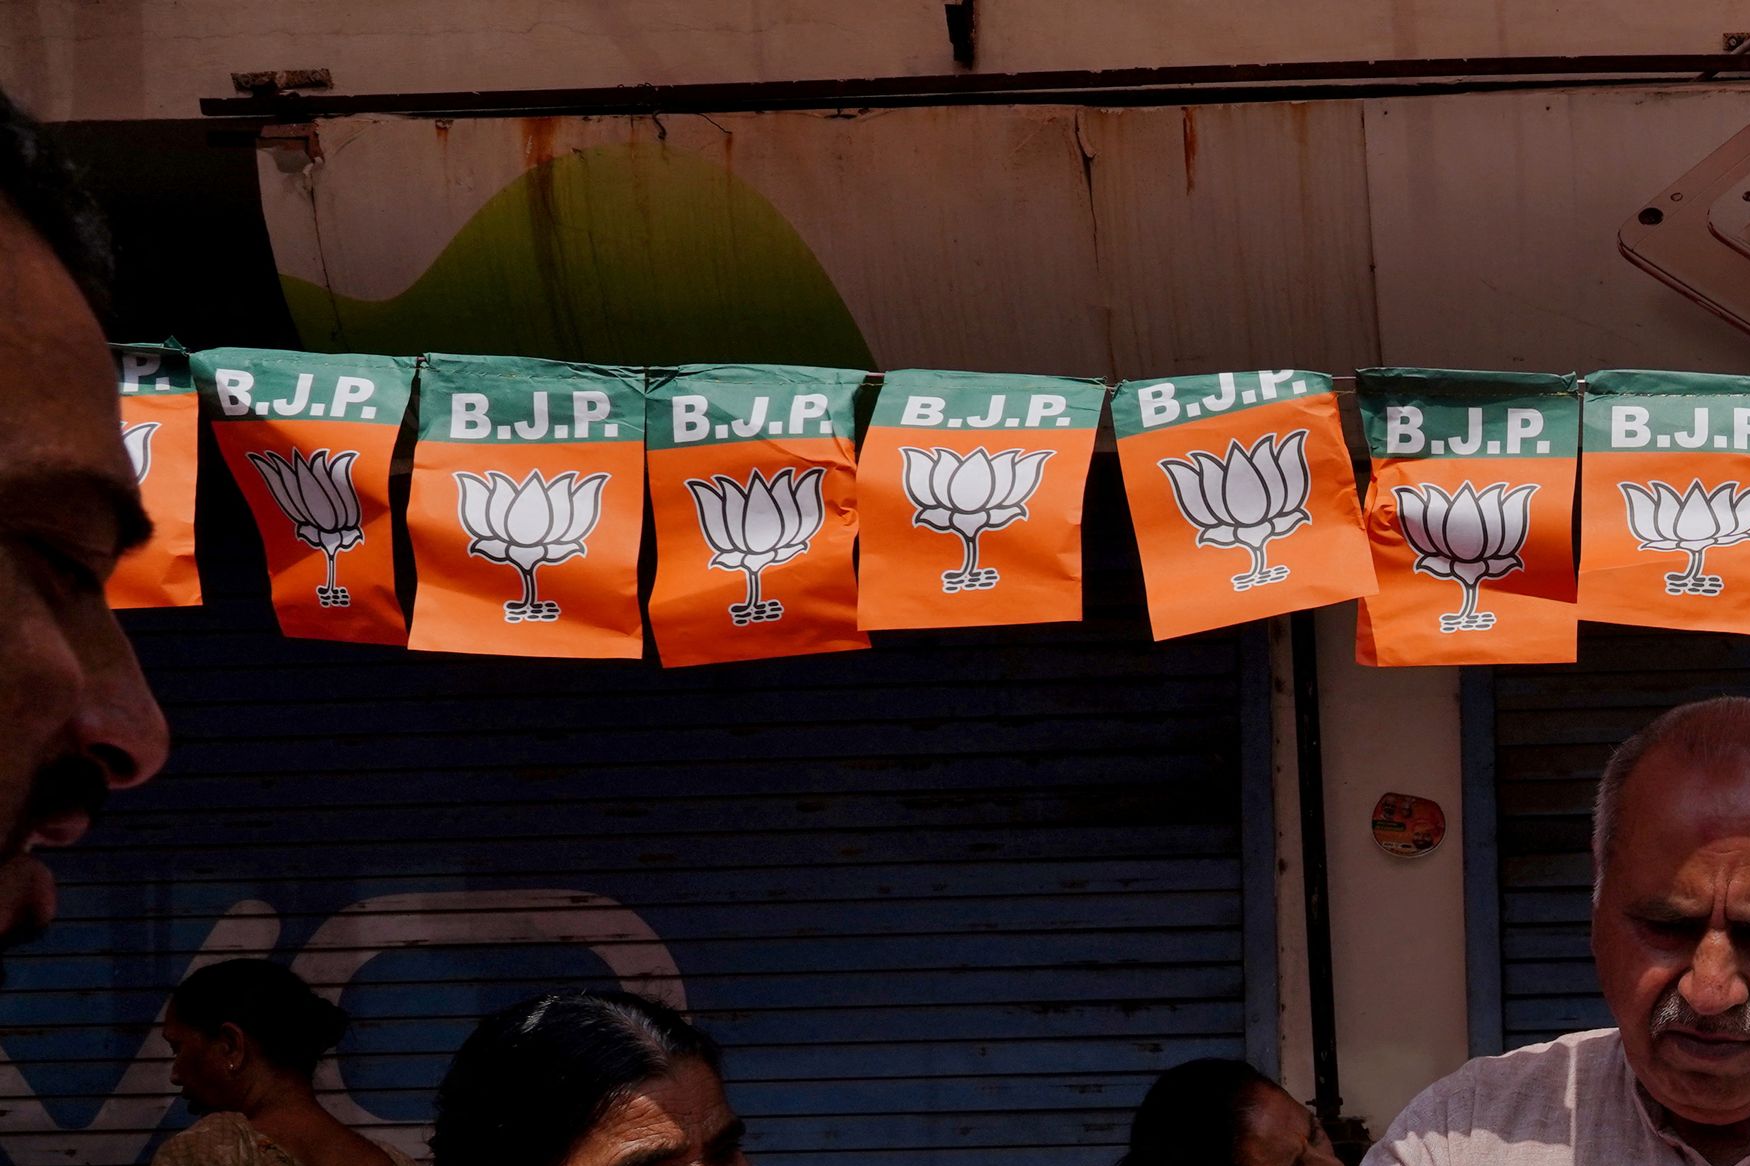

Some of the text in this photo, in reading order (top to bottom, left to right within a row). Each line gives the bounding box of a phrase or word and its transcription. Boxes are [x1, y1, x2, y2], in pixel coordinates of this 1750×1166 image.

[122, 352, 170, 392] P.
[215, 368, 378, 420] B.J.P.
[450, 390, 620, 441] B.J.P.
[672, 393, 833, 443] B.J.P.
[900, 394, 1072, 428] B.J.P.
[1137, 368, 1308, 429] B.J.P.
[1386, 405, 1551, 456] B.J.P.
